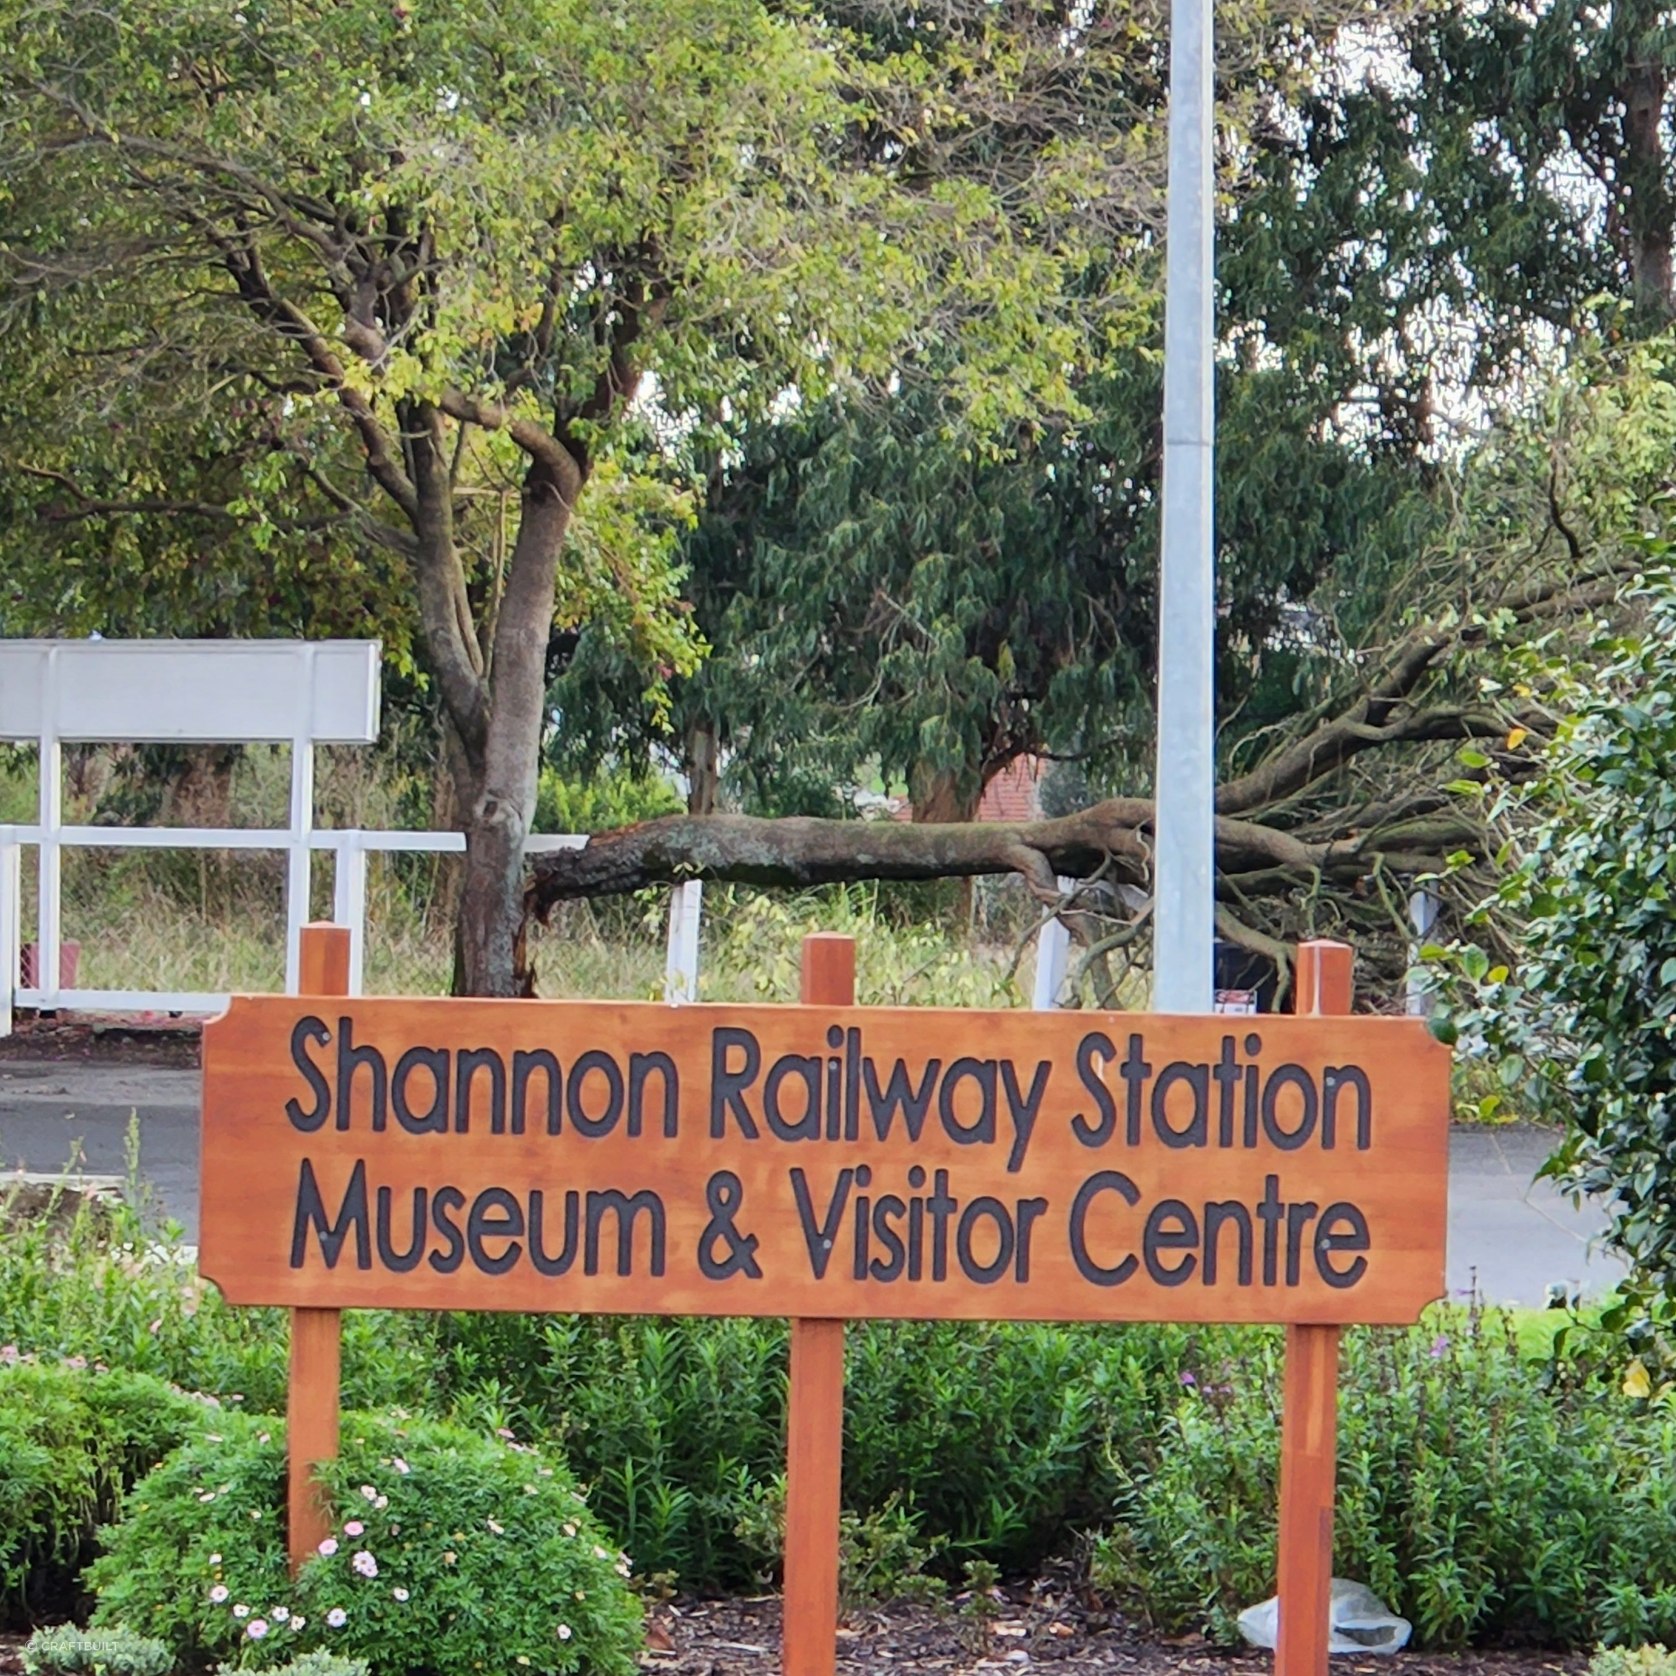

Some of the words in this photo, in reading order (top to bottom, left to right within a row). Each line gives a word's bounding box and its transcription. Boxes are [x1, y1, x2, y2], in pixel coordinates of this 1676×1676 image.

[285, 1015, 679, 1137] Shannon
[711, 1025, 1052, 1173] Railway
[1071, 1031, 1372, 1150] Station
[290, 1157, 666, 1277] Museum
[697, 1169, 763, 1281] &
[790, 1164, 1049, 1284] Visitor
[1069, 1170, 1371, 1288] Centre
